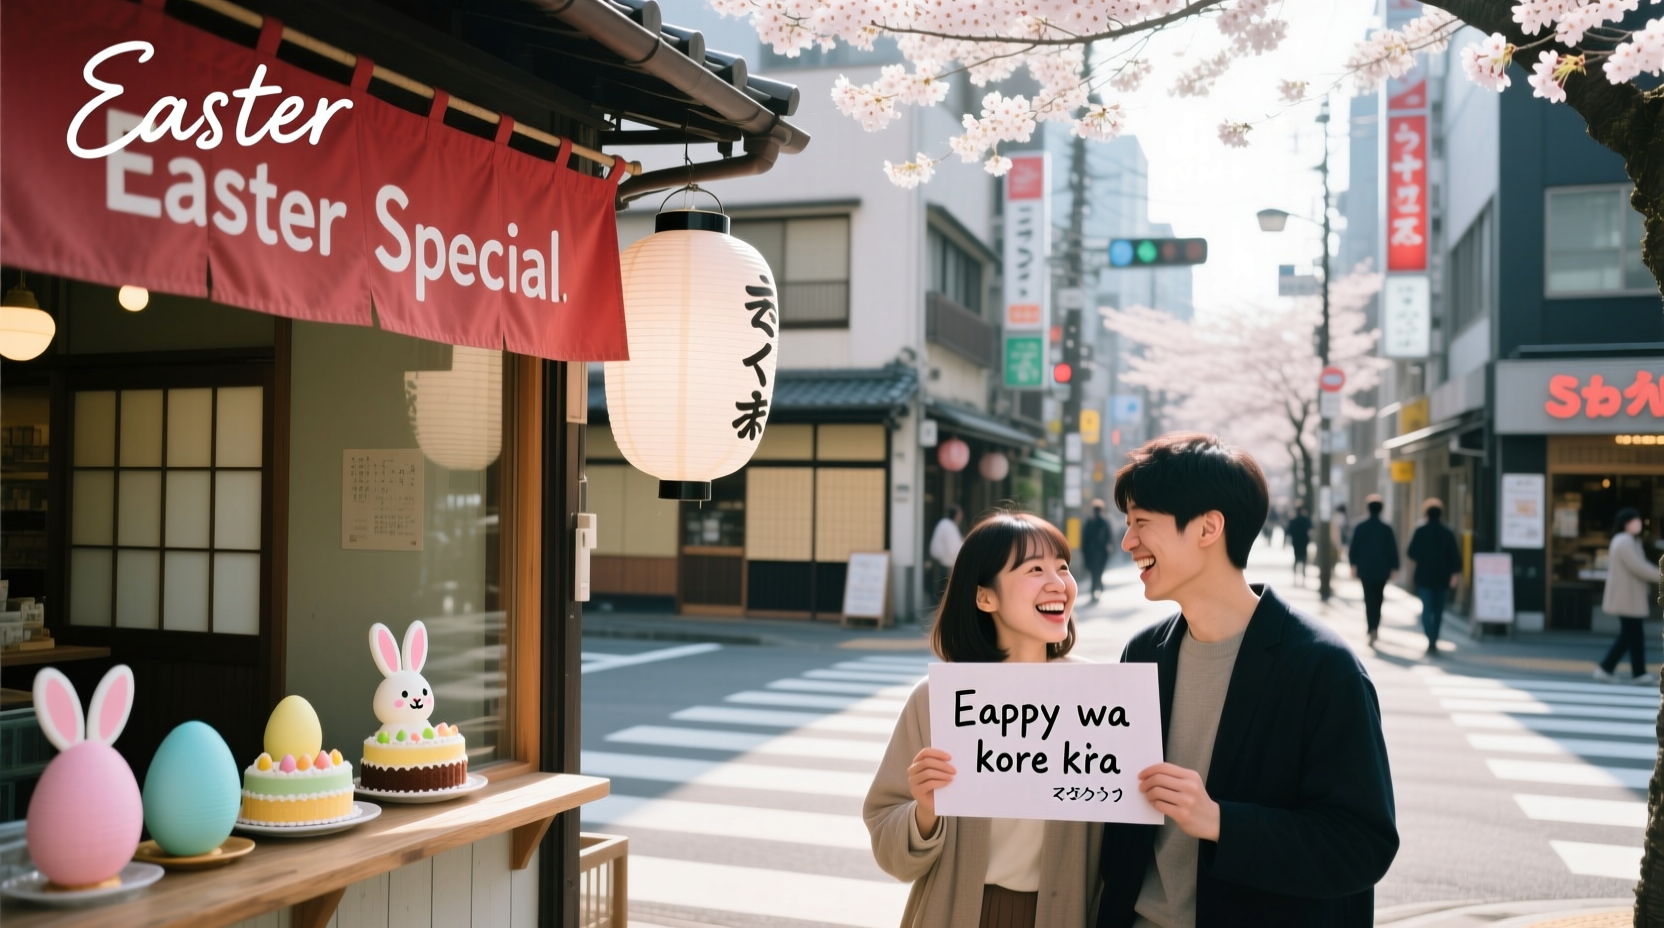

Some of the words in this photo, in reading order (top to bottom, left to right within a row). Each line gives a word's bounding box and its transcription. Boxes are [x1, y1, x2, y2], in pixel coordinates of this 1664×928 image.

[106, 107, 347, 256] Easter
[955, 689, 1060, 740] Eappy
[1077, 705, 1130, 727] wa
[976, 739, 1049, 773] kore
